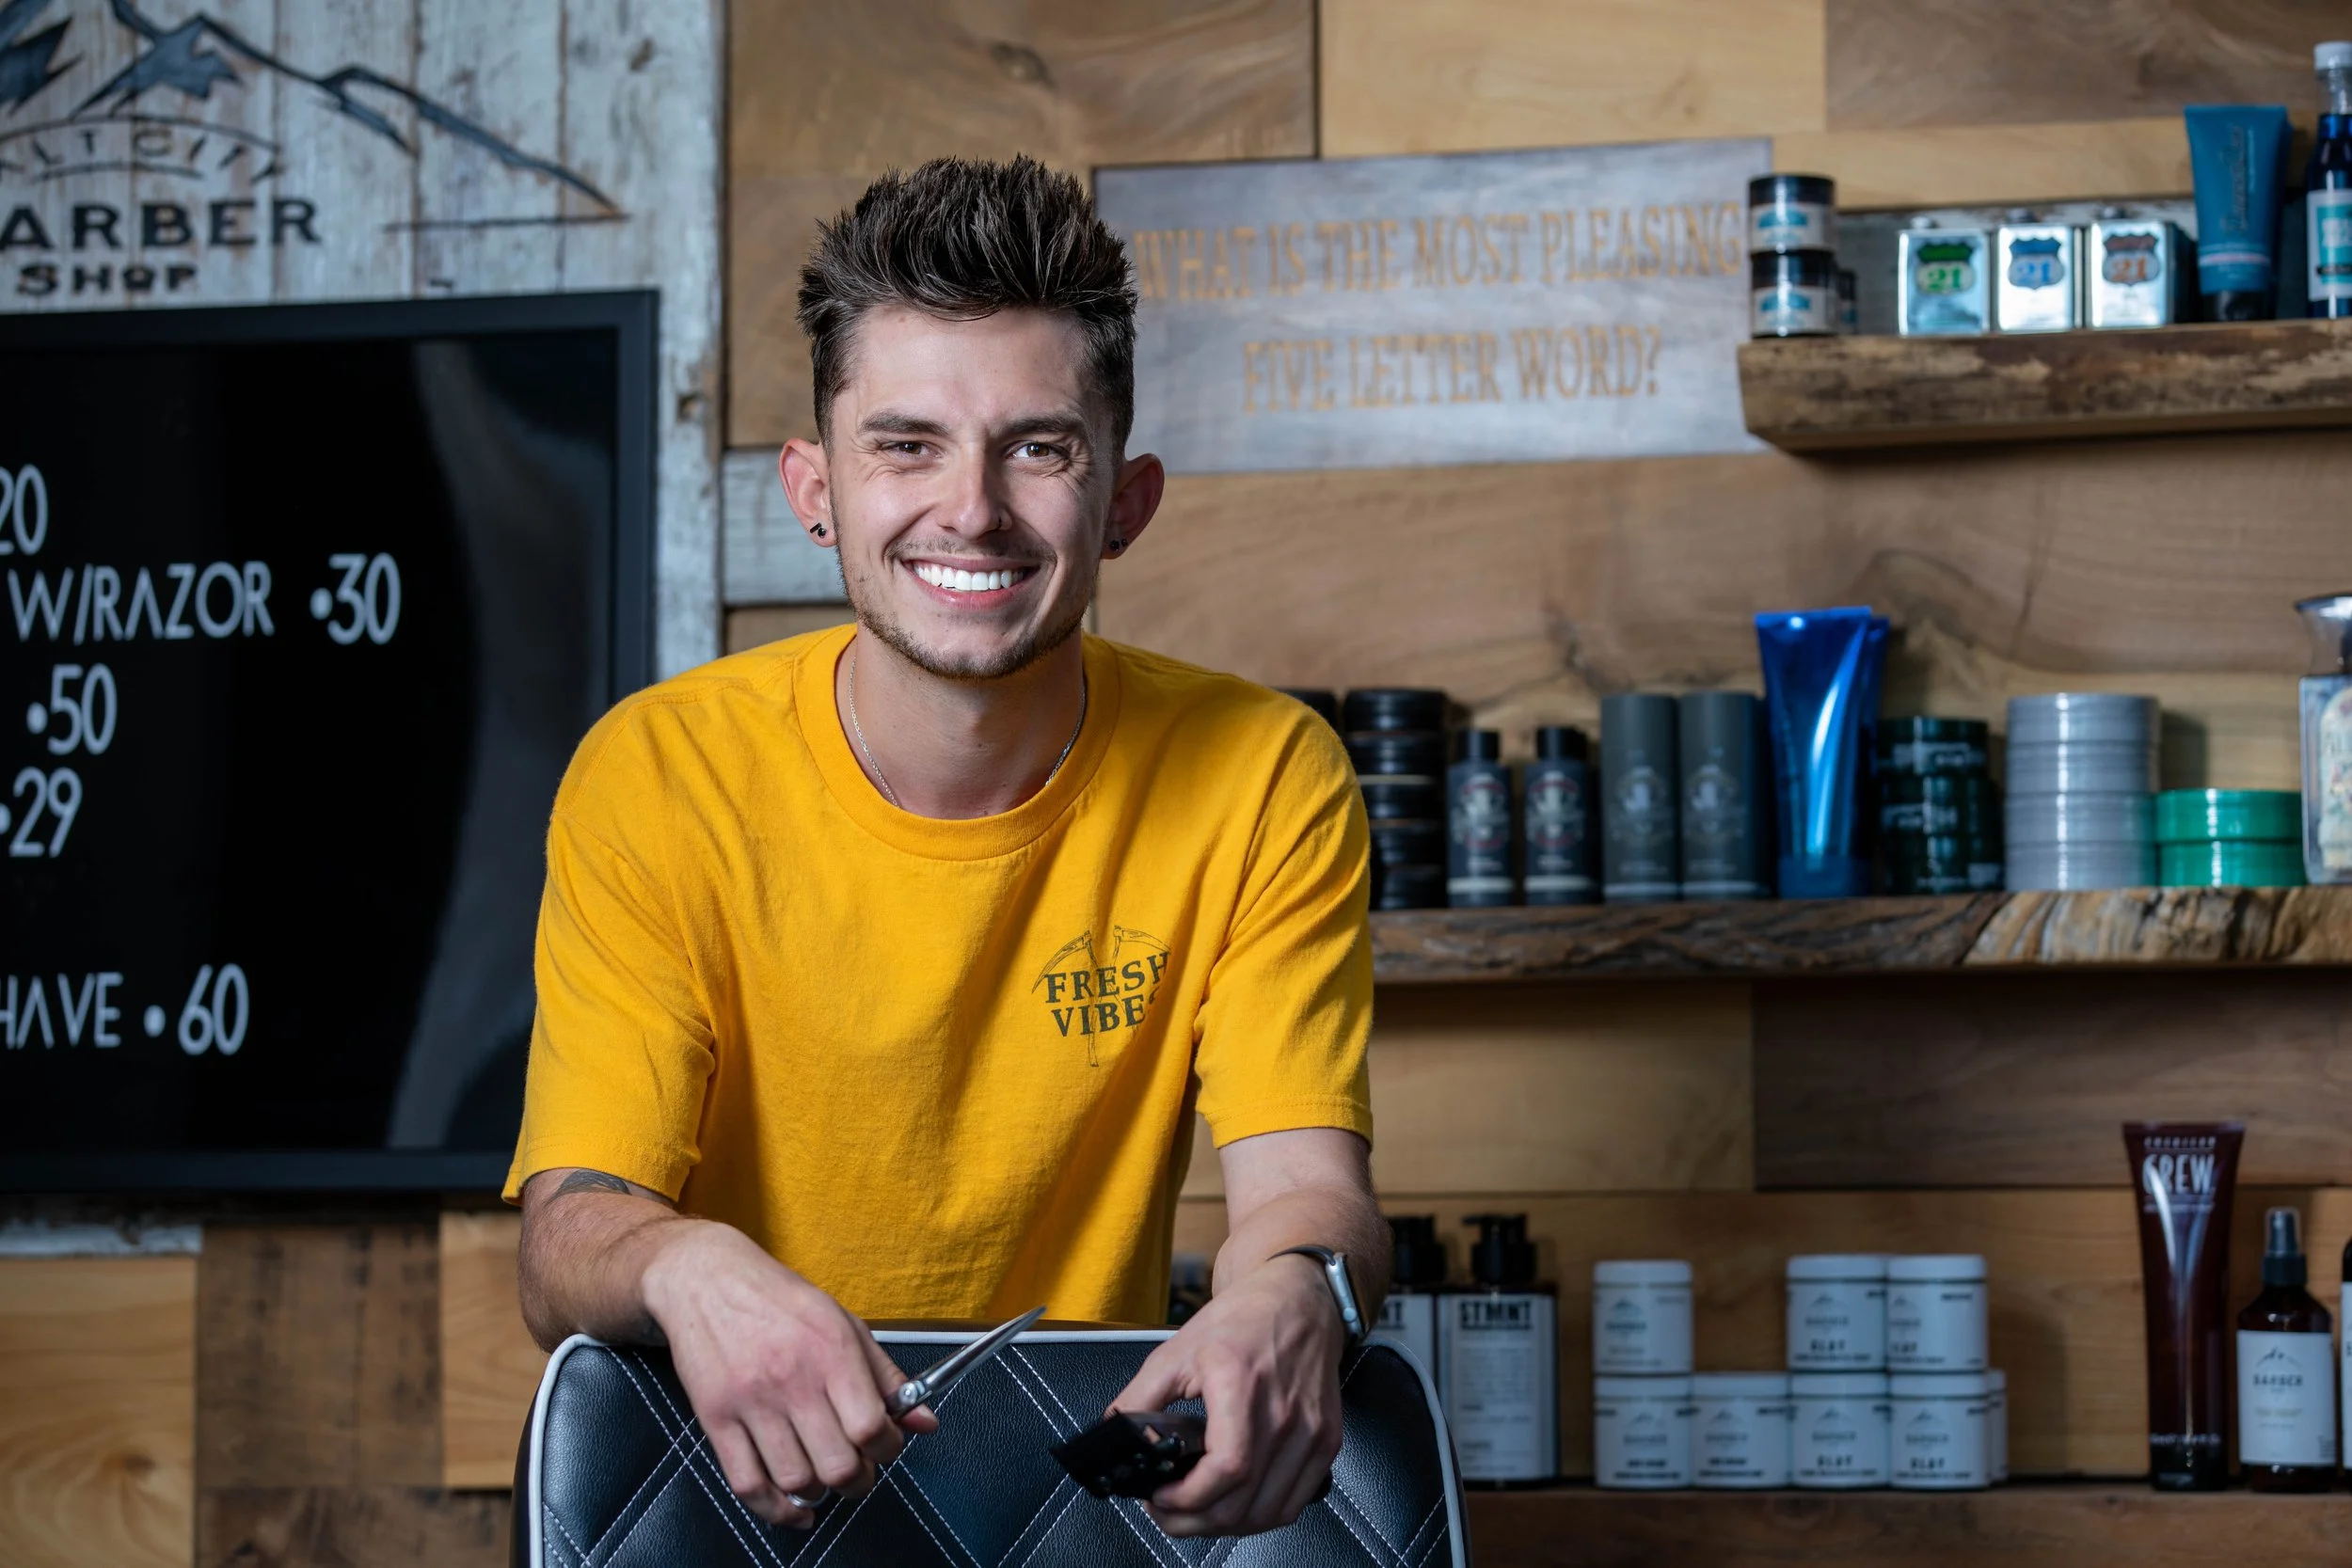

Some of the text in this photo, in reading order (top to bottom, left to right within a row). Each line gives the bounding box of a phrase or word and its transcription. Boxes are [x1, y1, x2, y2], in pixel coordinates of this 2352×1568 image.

[1133, 200, 1741, 301] WHAT IS THE MOST PLEASING
[2111, 256, 2148, 283] 21
[17, 261, 198, 295] SHOP
[1927, 265, 1963, 293] 21
[2017, 261, 2052, 285] 21
[1242, 324, 1662, 415] FIVE LETTER WORD?
[1043, 951, 1171, 1004] FRESH
[2141, 1153, 2215, 1195] CREW
